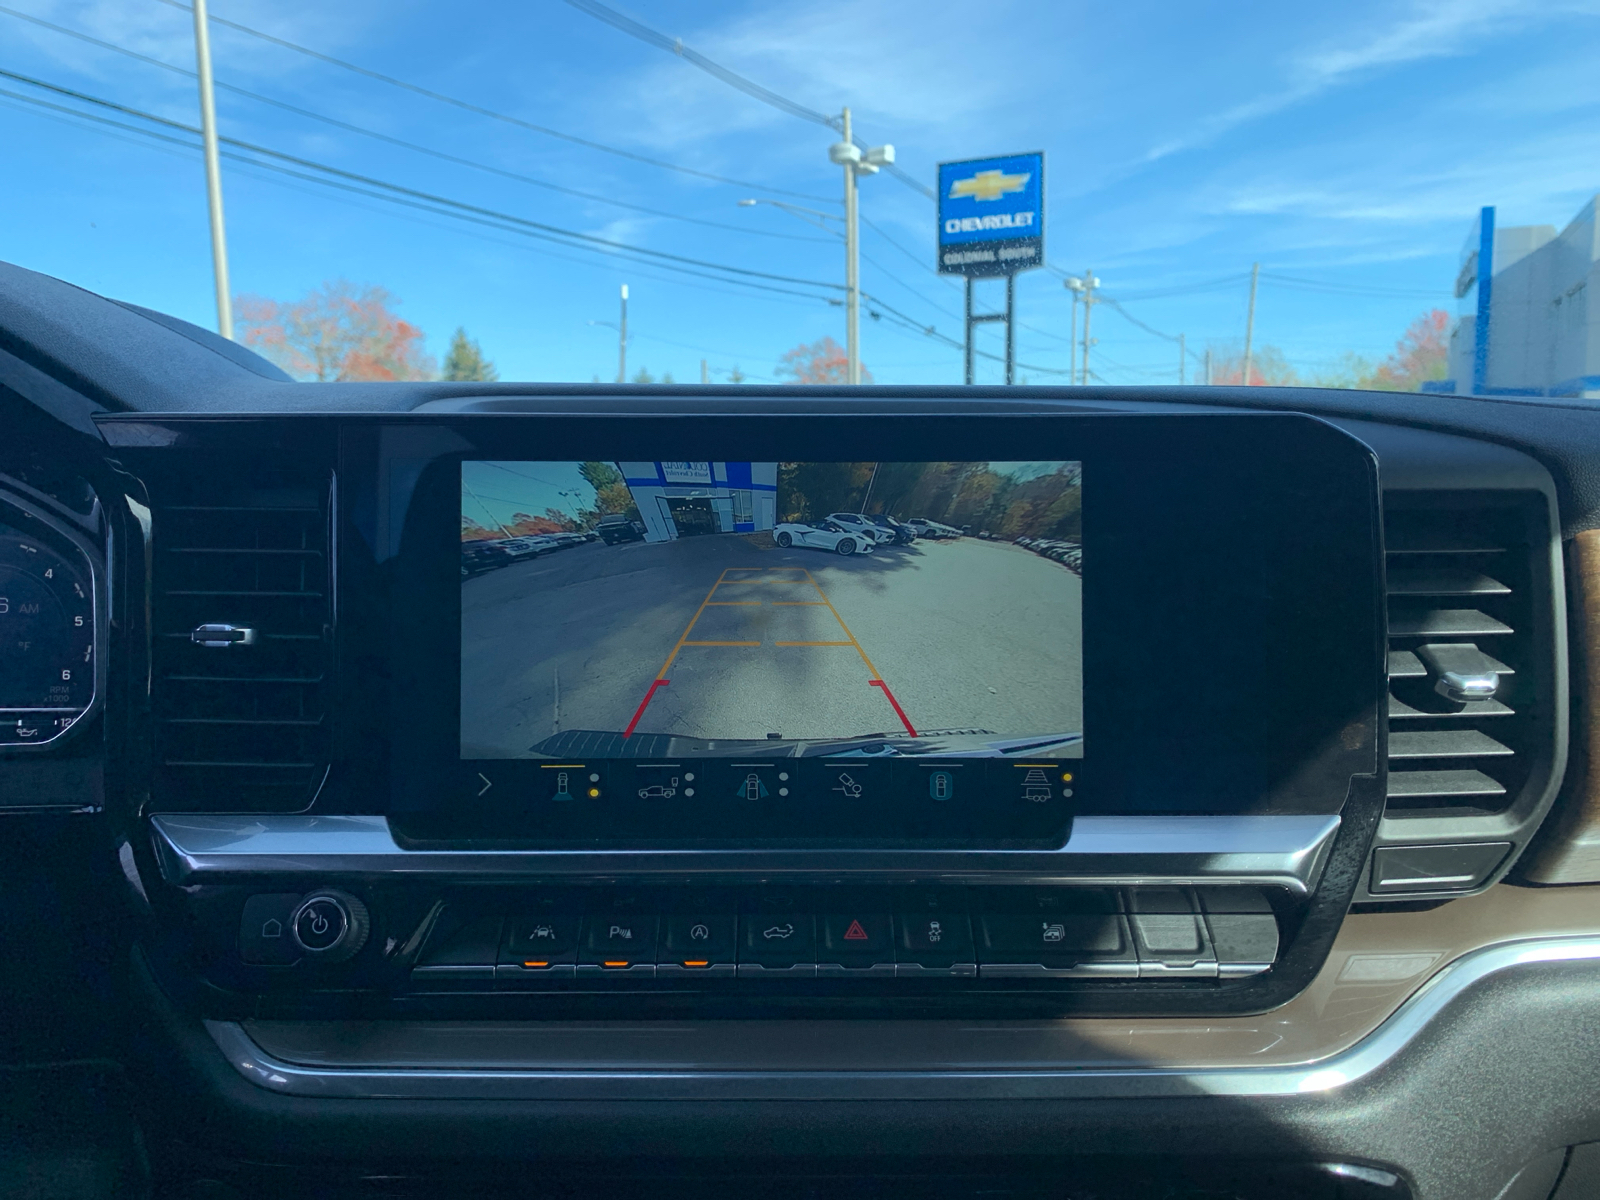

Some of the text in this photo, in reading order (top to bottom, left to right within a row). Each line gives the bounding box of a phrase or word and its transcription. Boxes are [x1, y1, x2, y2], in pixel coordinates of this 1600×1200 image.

[945, 212, 1034, 233] CHEVROLET
[44, 568, 54, 579] 4
[19, 603, 40, 614] AM
[74, 616, 84, 627] 5
[62, 669, 71, 681] 6
[49, 686, 70, 694] RPM
